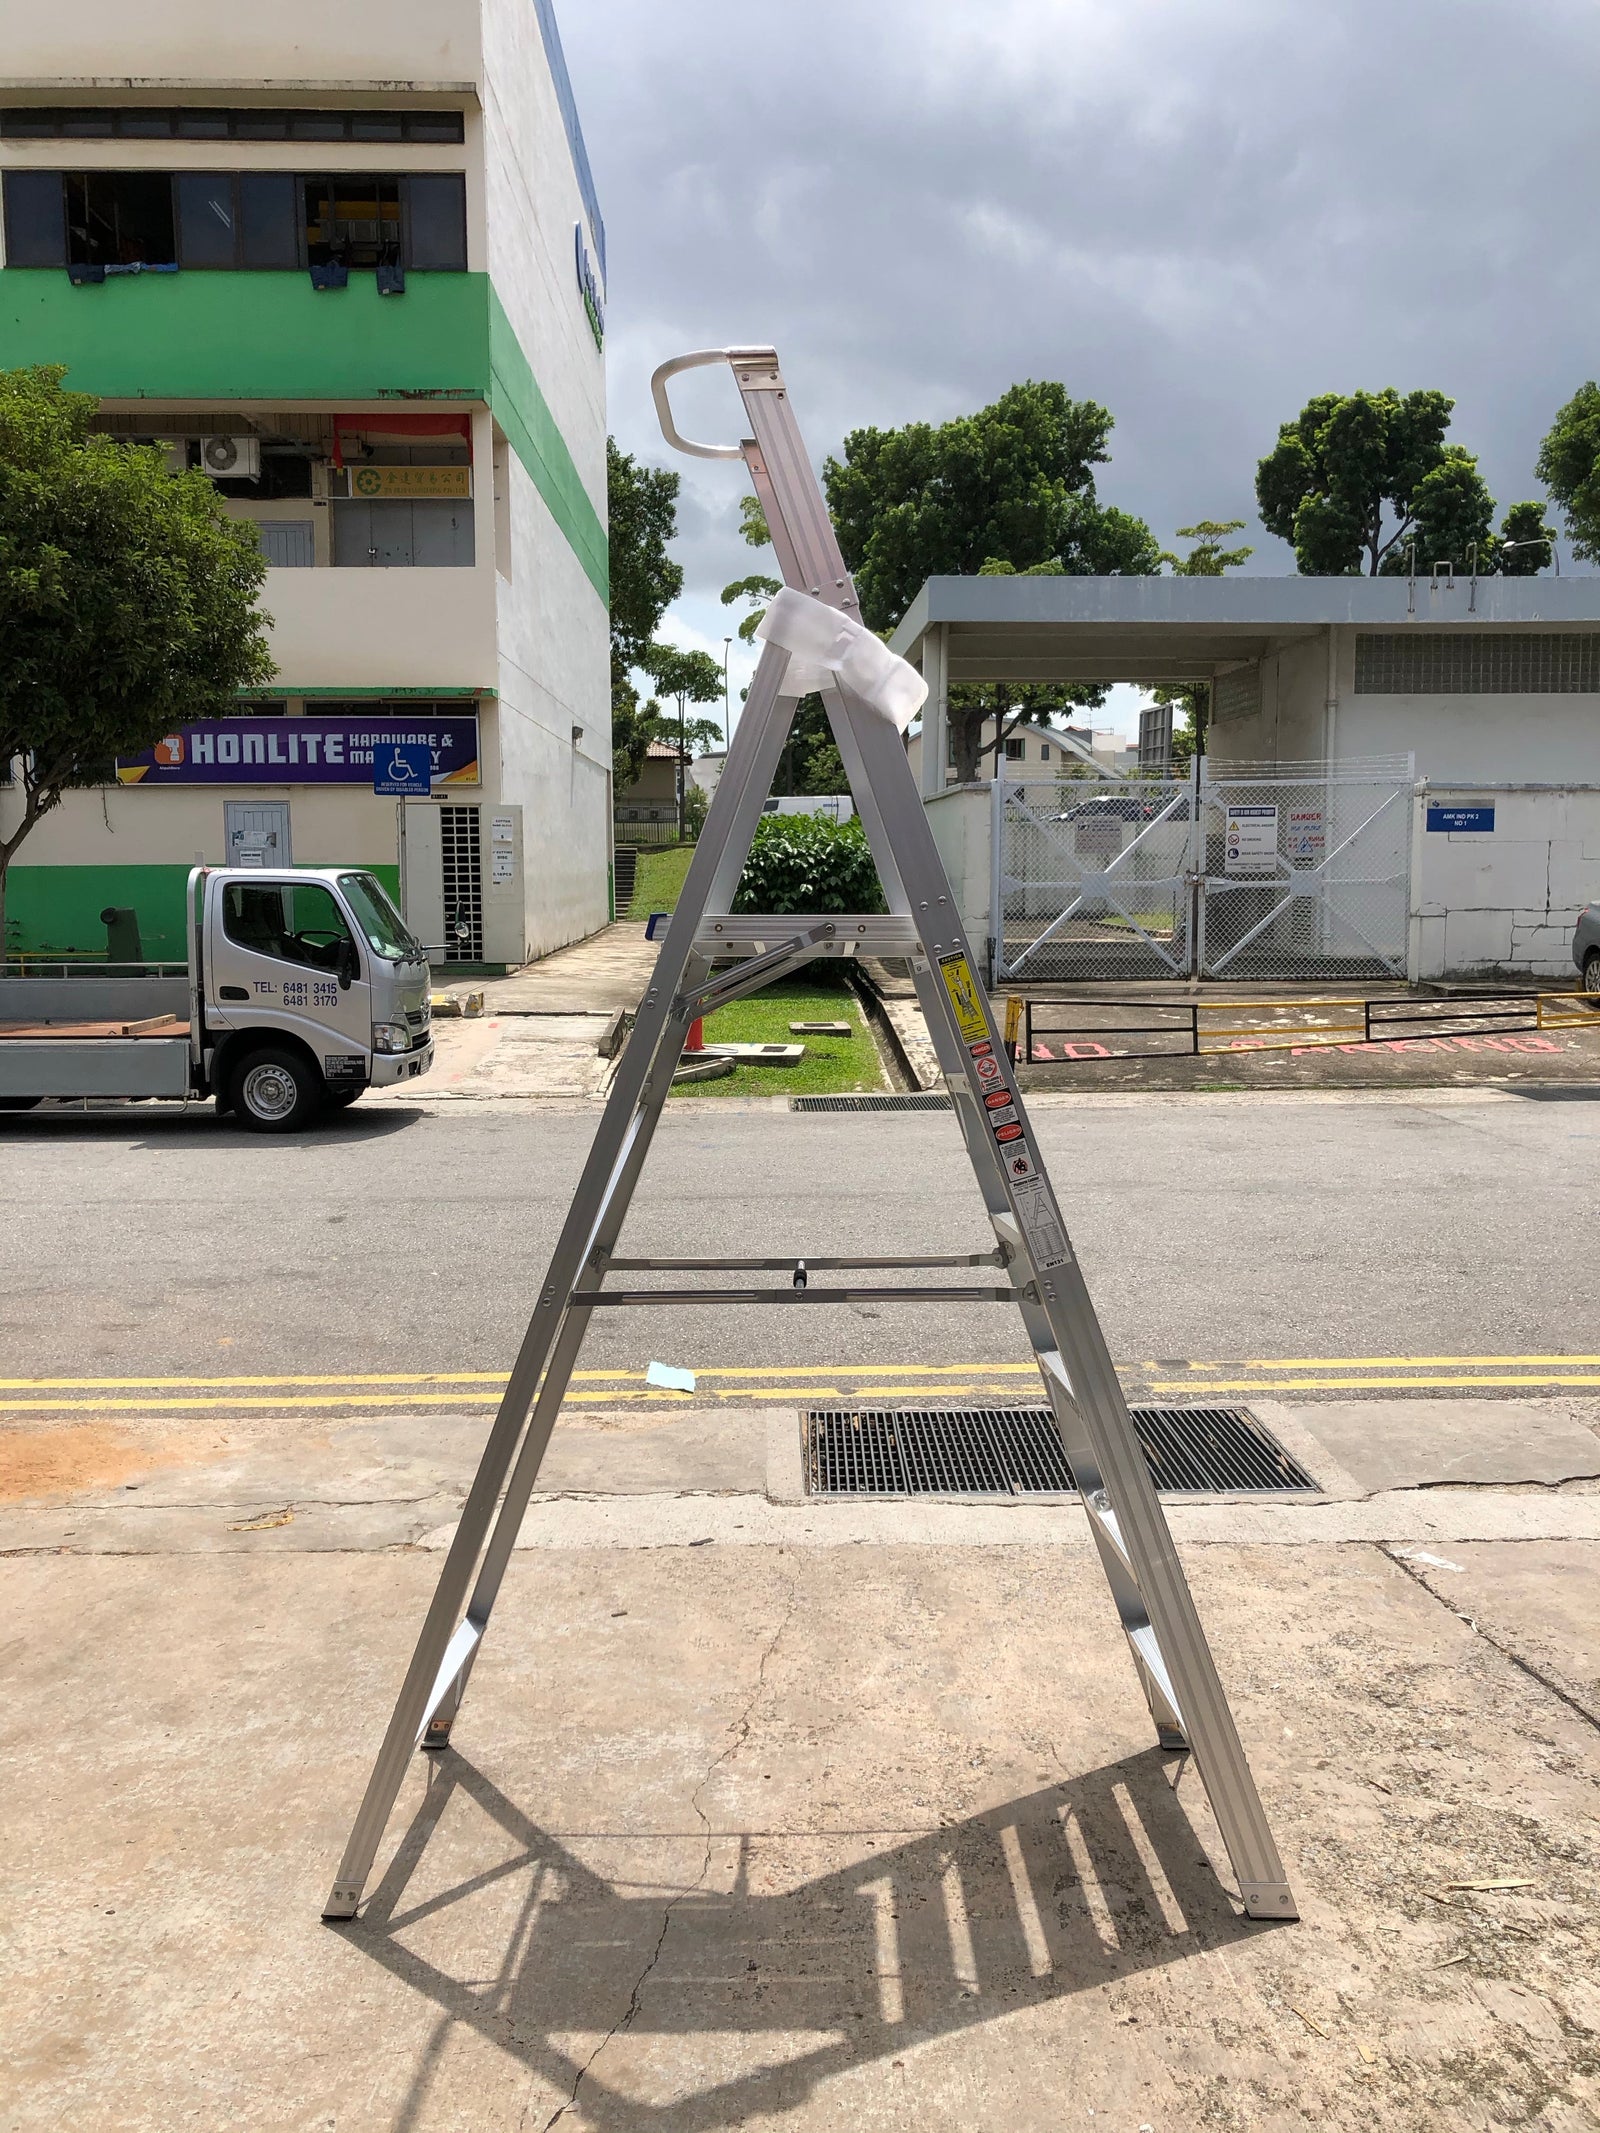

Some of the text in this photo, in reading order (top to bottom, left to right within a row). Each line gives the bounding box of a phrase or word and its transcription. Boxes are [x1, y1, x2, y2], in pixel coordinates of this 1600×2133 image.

[441, 734, 453, 747] &
[191, 733, 345, 764] HONLITE
[941, 953, 962, 963] CAUTION
[253, 981, 337, 994] TEL: 6481 3415
[283, 995, 338, 1006] 6481 3170
[987, 1095, 1010, 1105] DANGER
